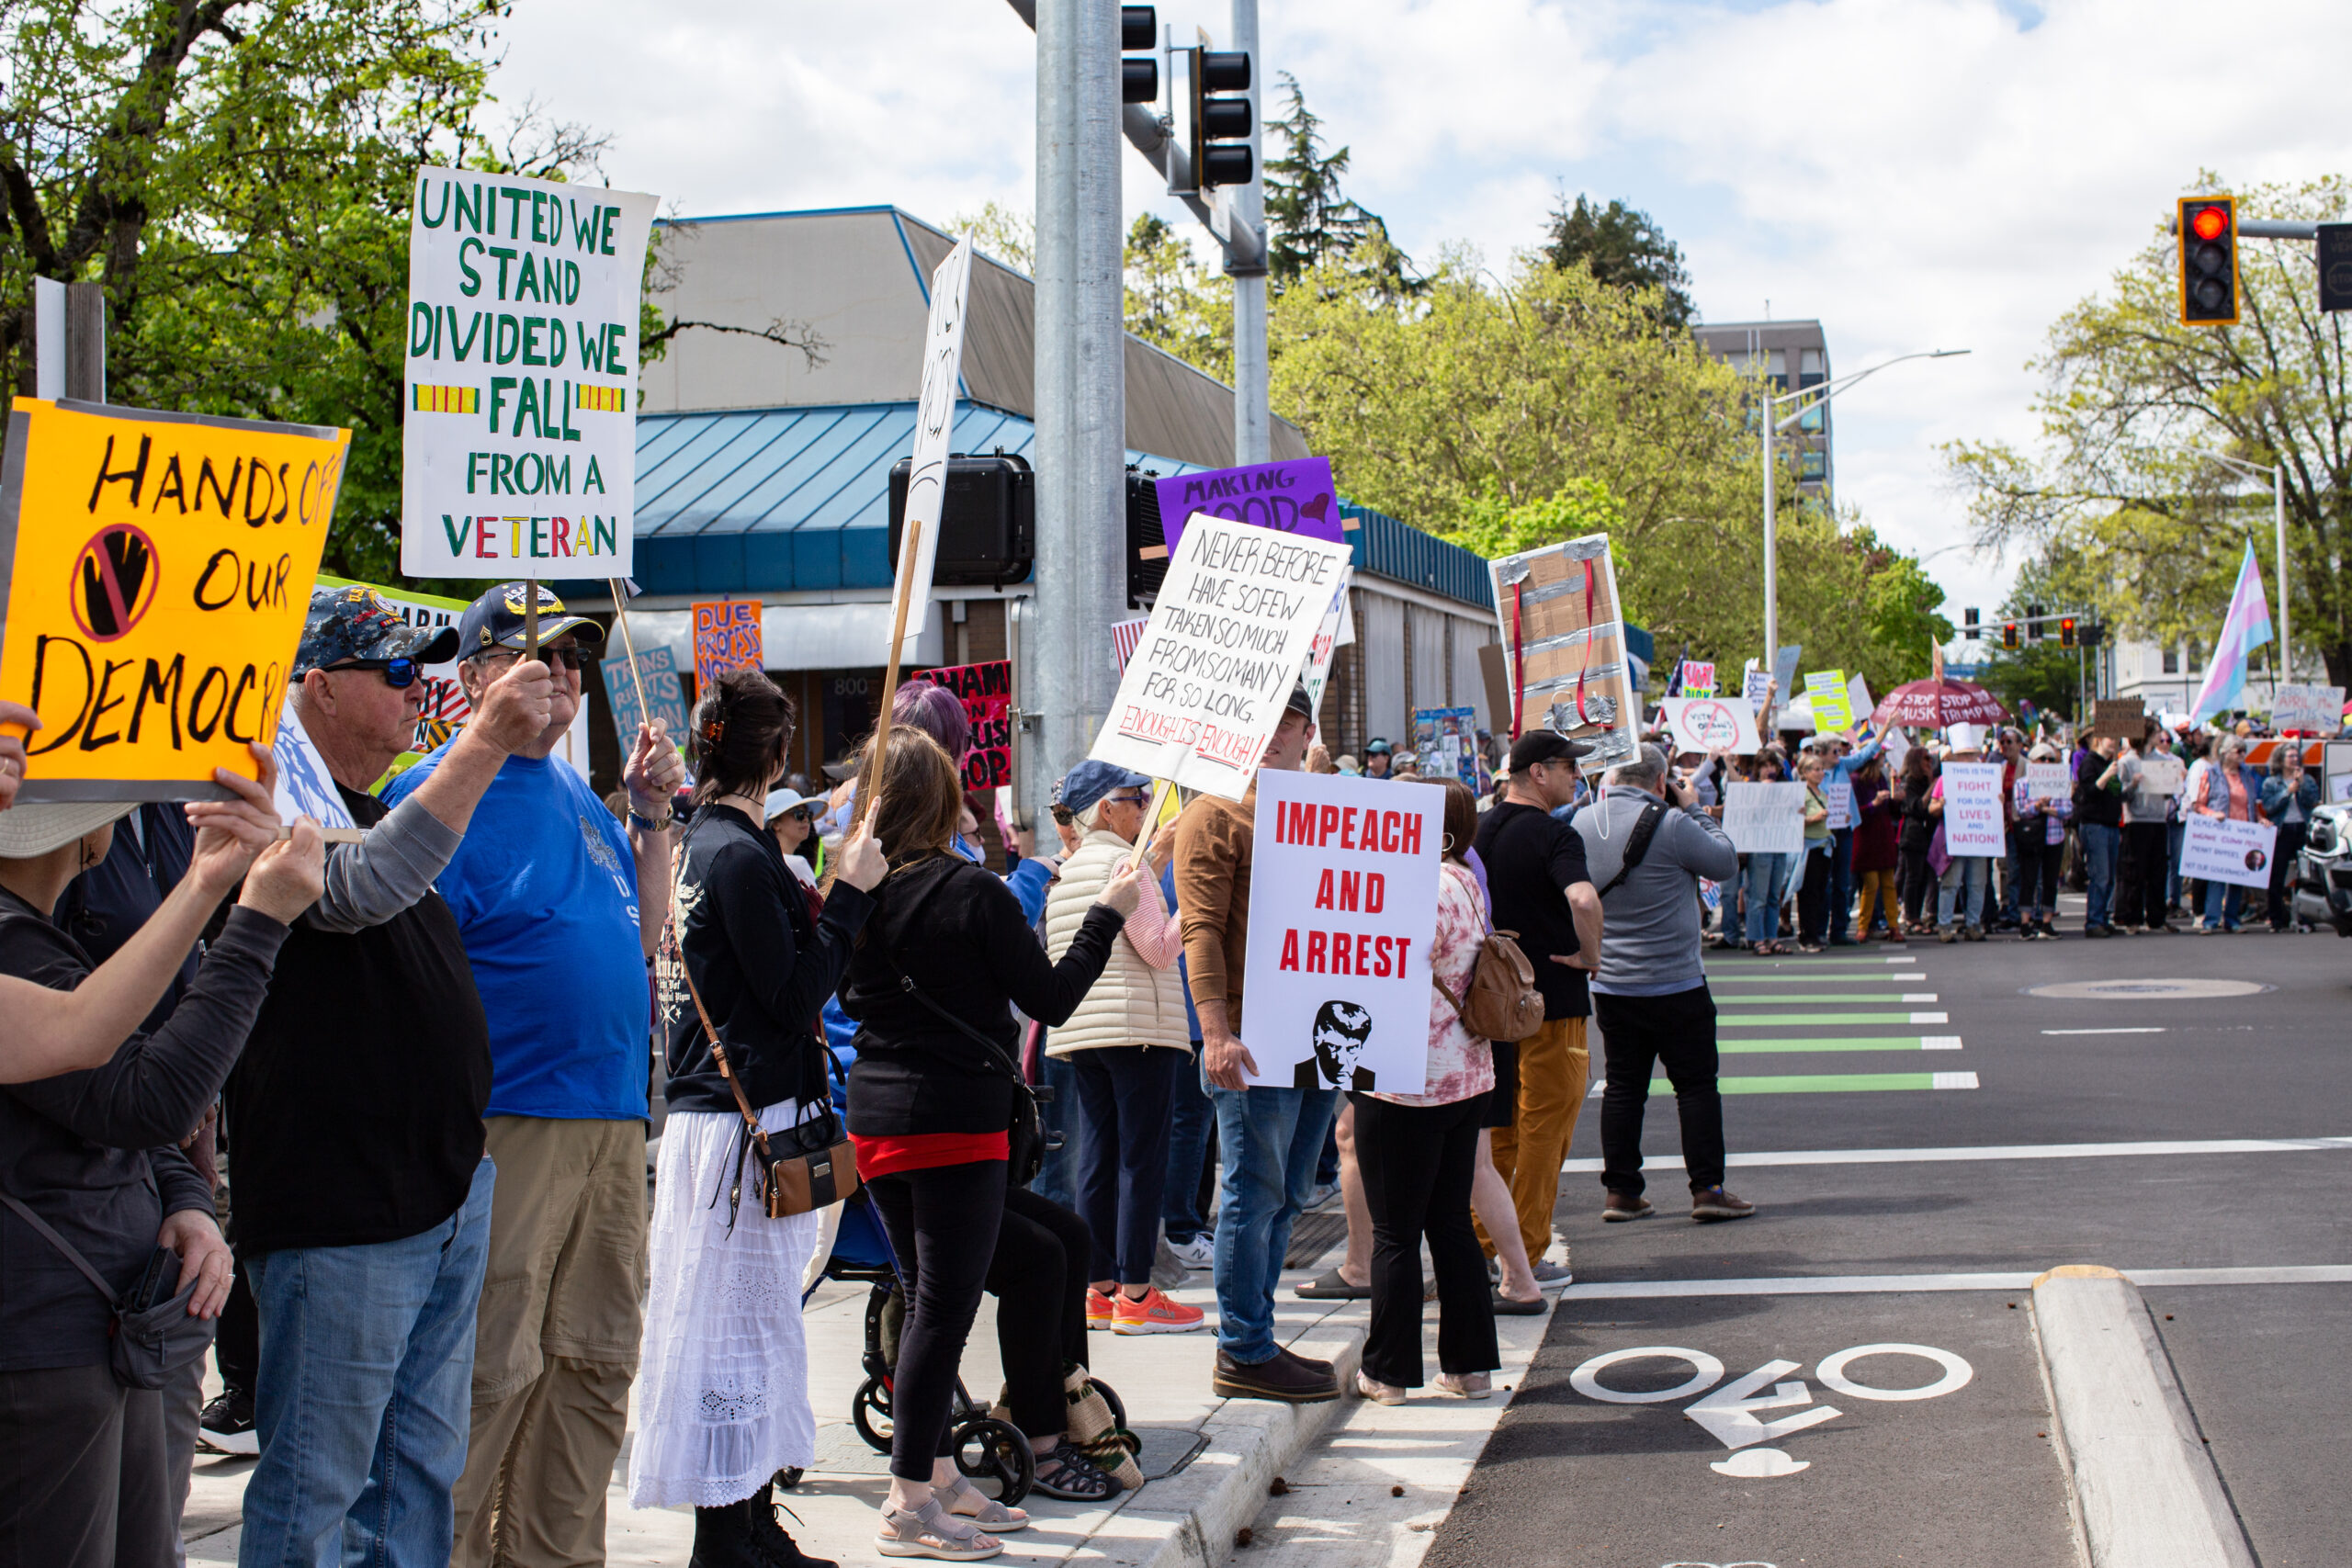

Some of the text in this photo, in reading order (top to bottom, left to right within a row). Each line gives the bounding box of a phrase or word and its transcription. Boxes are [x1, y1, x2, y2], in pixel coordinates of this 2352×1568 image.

[421, 178, 621, 255] UNITED WE
[459, 237, 581, 306] STAND
[412, 301, 627, 375] DIVIDED WE
[490, 377, 581, 441] FALL
[88, 433, 289, 528] HANDS
[467, 452, 605, 495] FROM A
[1183, 468, 1297, 504] MAKING
[442, 514, 616, 558] VETERAN
[1191, 529, 1336, 586] NEVER BEFORE
[194, 548, 291, 614] OUR
[1188, 572, 1234, 607] HAVE
[697, 604, 752, 632] DUE
[1165, 605, 1216, 638] TAKEN
[1238, 625, 1288, 654] MUCH
[696, 624, 760, 662] PROCESS
[27, 634, 287, 756] DEMOCR
[835, 678, 867, 695] 800
[919, 662, 1011, 699] HAM
[1142, 671, 1254, 724] FOR SO LONG.
[1901, 705, 1936, 720] MUSK
[1904, 694, 1935, 705] STOP
[1940, 694, 1971, 707] STOP
[1940, 705, 1983, 723] TRUMP
[2278, 696, 2311, 708] APRIL
[1120, 705, 1181, 742] ENOUGH
[1957, 781, 1991, 792] FIGHT
[2029, 765, 2066, 779] DEFEND
[1275, 800, 1422, 855] IMPEACH
[1959, 809, 1991, 820] LIVES
[1968, 822, 1984, 830] AND
[1952, 833, 1998, 844] NATION!
[1315, 868, 1385, 914] AND
[1279, 928, 1411, 979] ARREST
